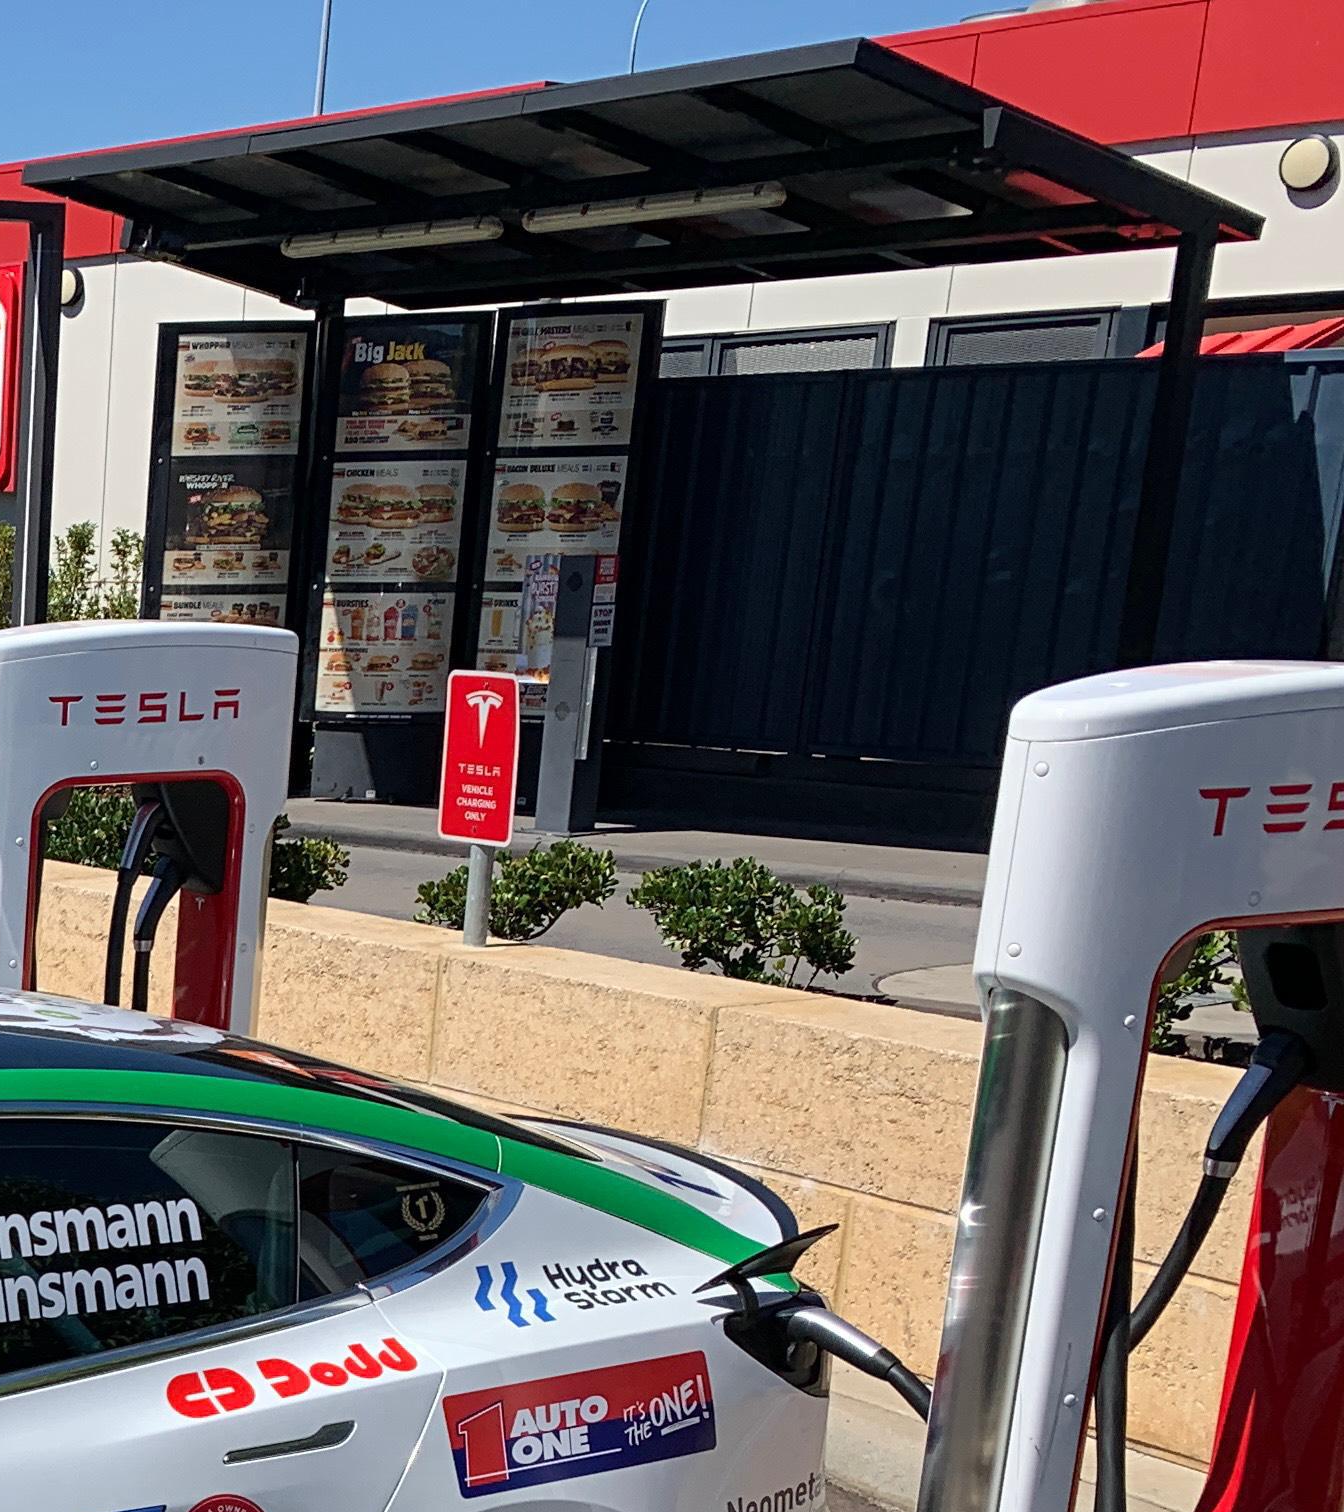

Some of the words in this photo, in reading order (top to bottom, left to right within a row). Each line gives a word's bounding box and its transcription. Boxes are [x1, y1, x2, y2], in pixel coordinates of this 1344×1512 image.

[354, 342, 384, 364] Big
[386, 341, 427, 362] Jack
[48, 688, 241, 726] TESLA
[458, 763, 501, 777] TESLA
[462, 784, 494, 796] VEHICLE
[456, 796, 497, 810] CHARGING
[464, 811, 487, 822] ONLY
[542, 1258, 648, 1290] Hydra
[256, 1337, 418, 1399] Dodd
[623, 1401, 645, 1423] IT'S
[649, 1374, 710, 1428] ONE!
[510, 1395, 609, 1438] AUTO
[511, 1425, 590, 1465] ONE
[624, 1421, 652, 1446] THE
